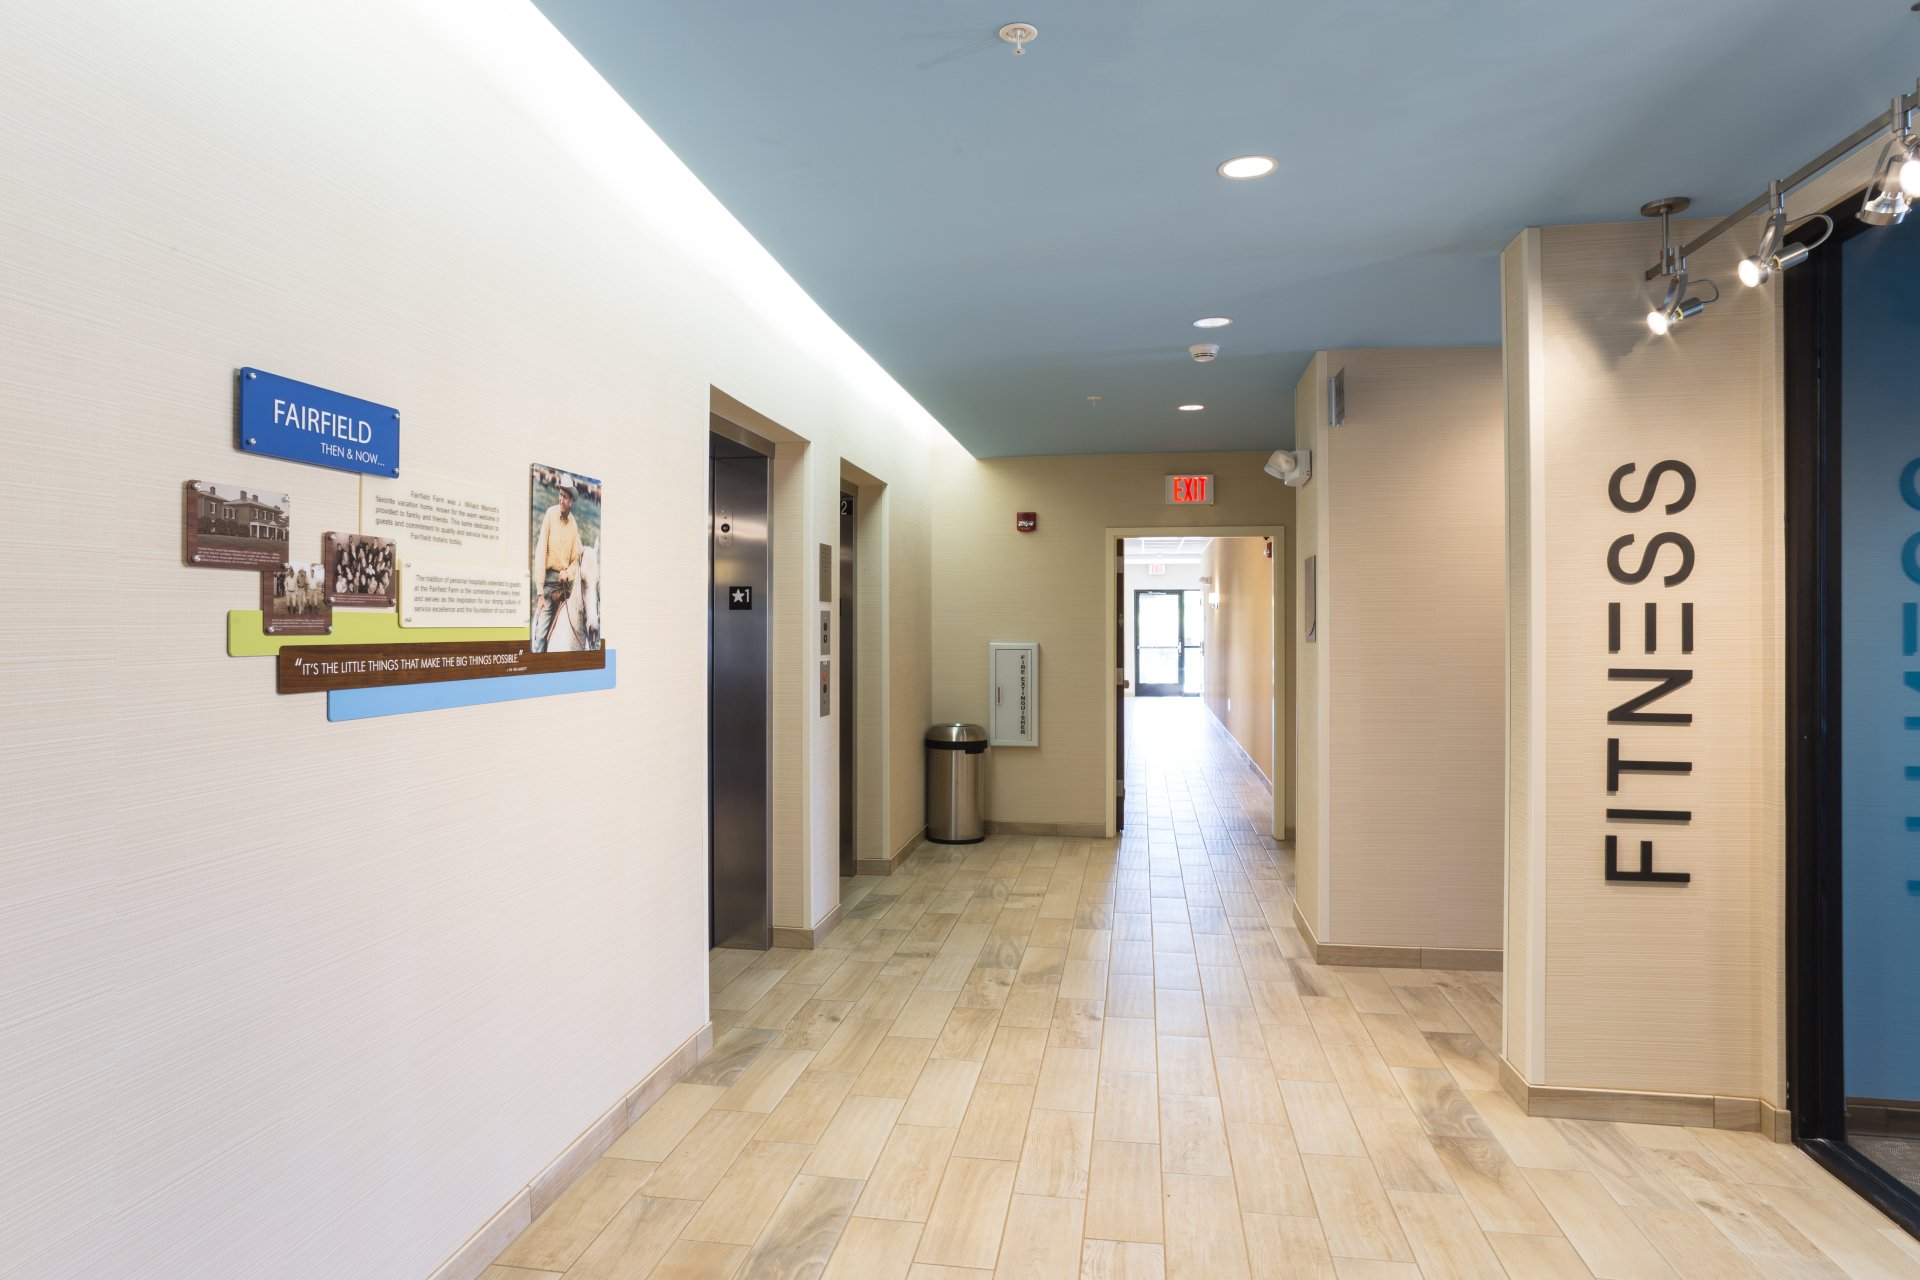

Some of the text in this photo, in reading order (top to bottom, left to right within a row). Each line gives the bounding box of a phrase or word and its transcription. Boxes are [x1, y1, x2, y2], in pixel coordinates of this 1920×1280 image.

[274, 399, 371, 444] FAIRFIELD
[321, 442, 344, 458] THEN
[347, 449, 353, 460] &
[410, 490, 431, 501] Fairfield
[432, 494, 445, 503] Farm
[1173, 477, 1207, 503] EXIT
[375, 495, 396, 505] favorite
[397, 500, 419, 509] vacation
[841, 501, 848, 515] 2
[375, 507, 398, 516] provided
[406, 511, 421, 520] family
[375, 518, 394, 526] guests
[394, 519, 405, 527] and
[405, 521, 434, 532] commitment
[441, 526, 456, 536] quality
[410, 532, 432, 542] Fairfield
[432, 535, 448, 544] hotels
[416, 574, 425, 582] The
[429, 585, 447, 593] Fairfield
[745, 589, 750, 603] 1
[295, 657, 319, 676] "IT'S
[321, 662, 339, 675] THE
[341, 661, 366, 674] LITTLE
[368, 659, 399, 672] THINGS
[401, 658, 419, 670] THAT
[420, 657, 440, 669] MAKE
[442, 657, 455, 667] THE
[456, 656, 467, 667] BIG
[469, 655, 492, 666] THINGS
[1605, 459, 1696, 886] FITNESS
